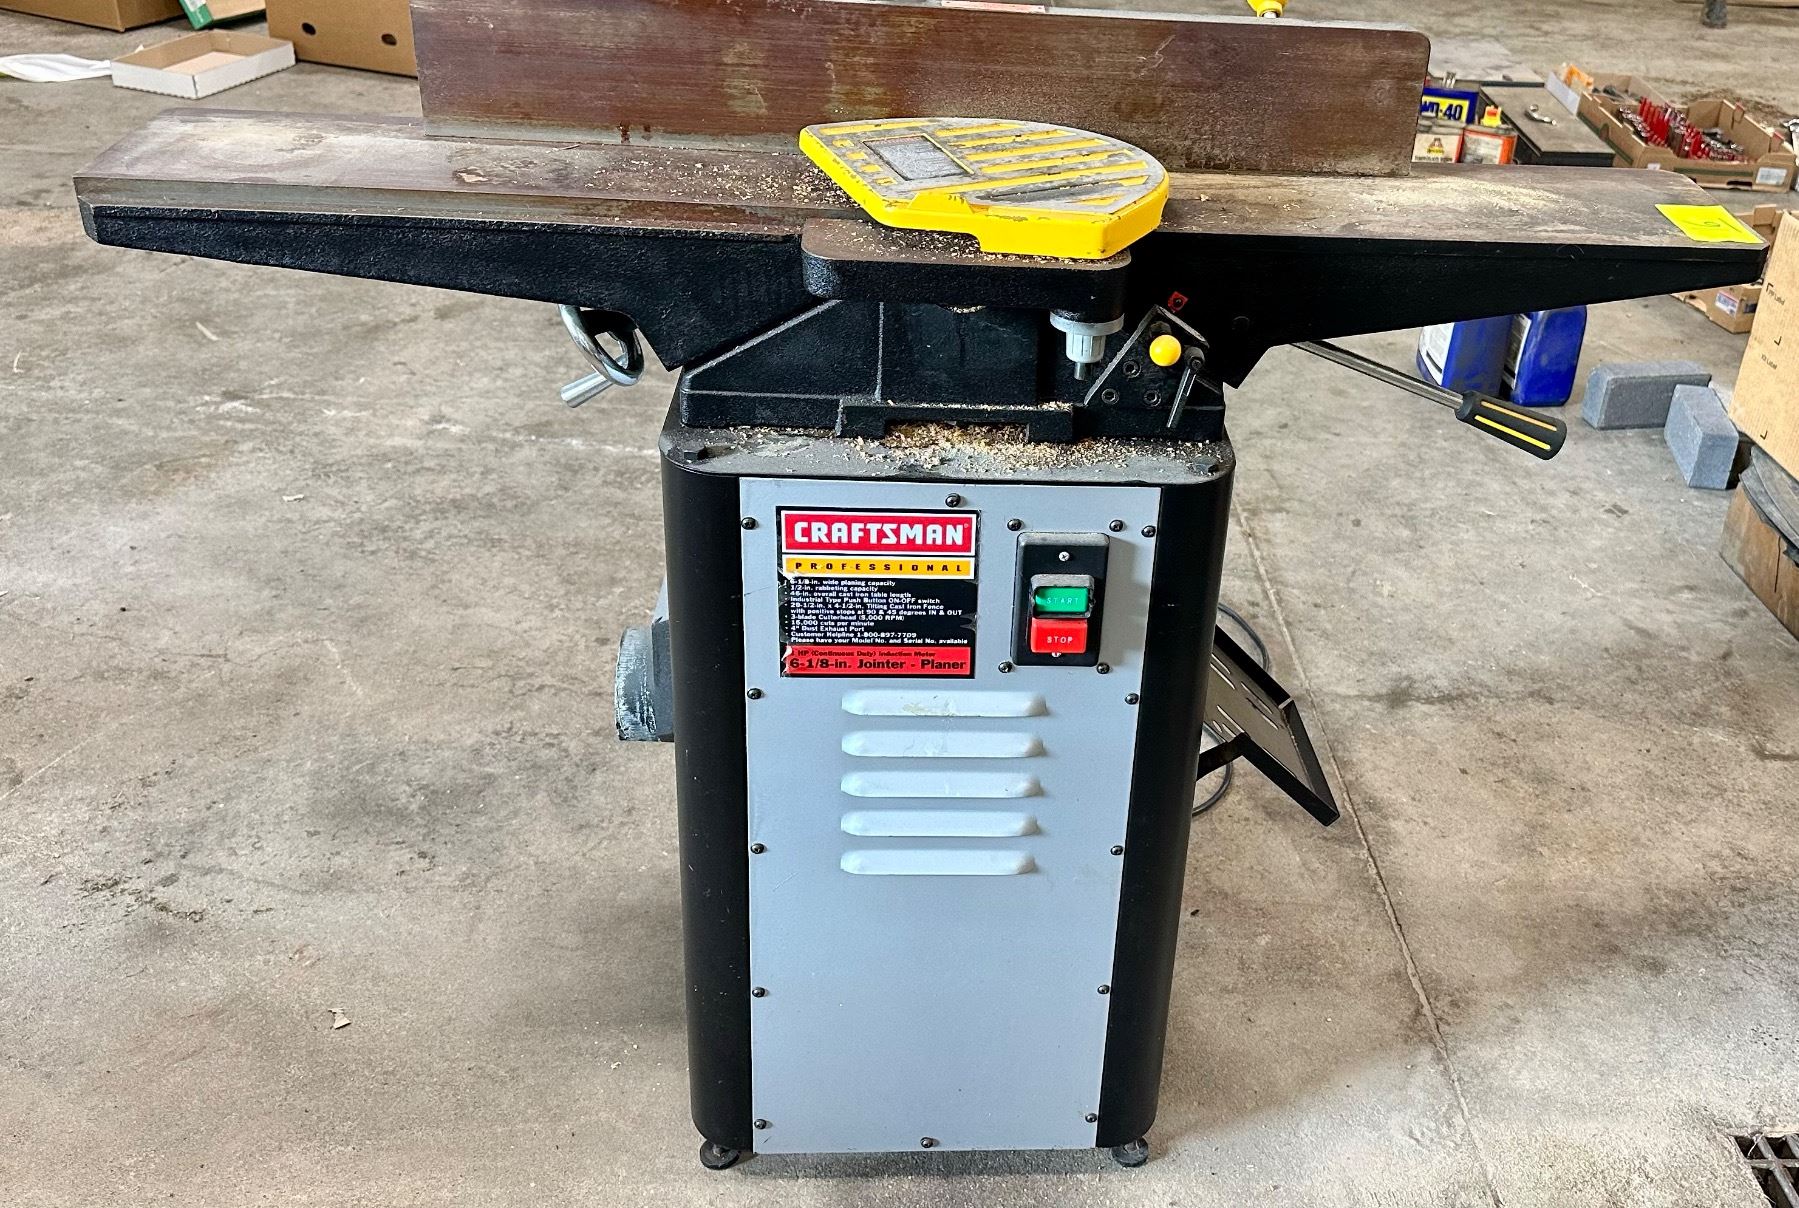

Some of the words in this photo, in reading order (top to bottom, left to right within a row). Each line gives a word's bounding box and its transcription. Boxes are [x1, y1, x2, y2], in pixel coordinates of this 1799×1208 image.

[794, 521, 964, 546] CRAFTSMAN
[795, 562, 962, 572] PROFESSIONAL
[790, 658, 852, 669] 6-1/8-in.
[857, 658, 906, 670] Jointer
[920, 659, 966, 670] Planer
